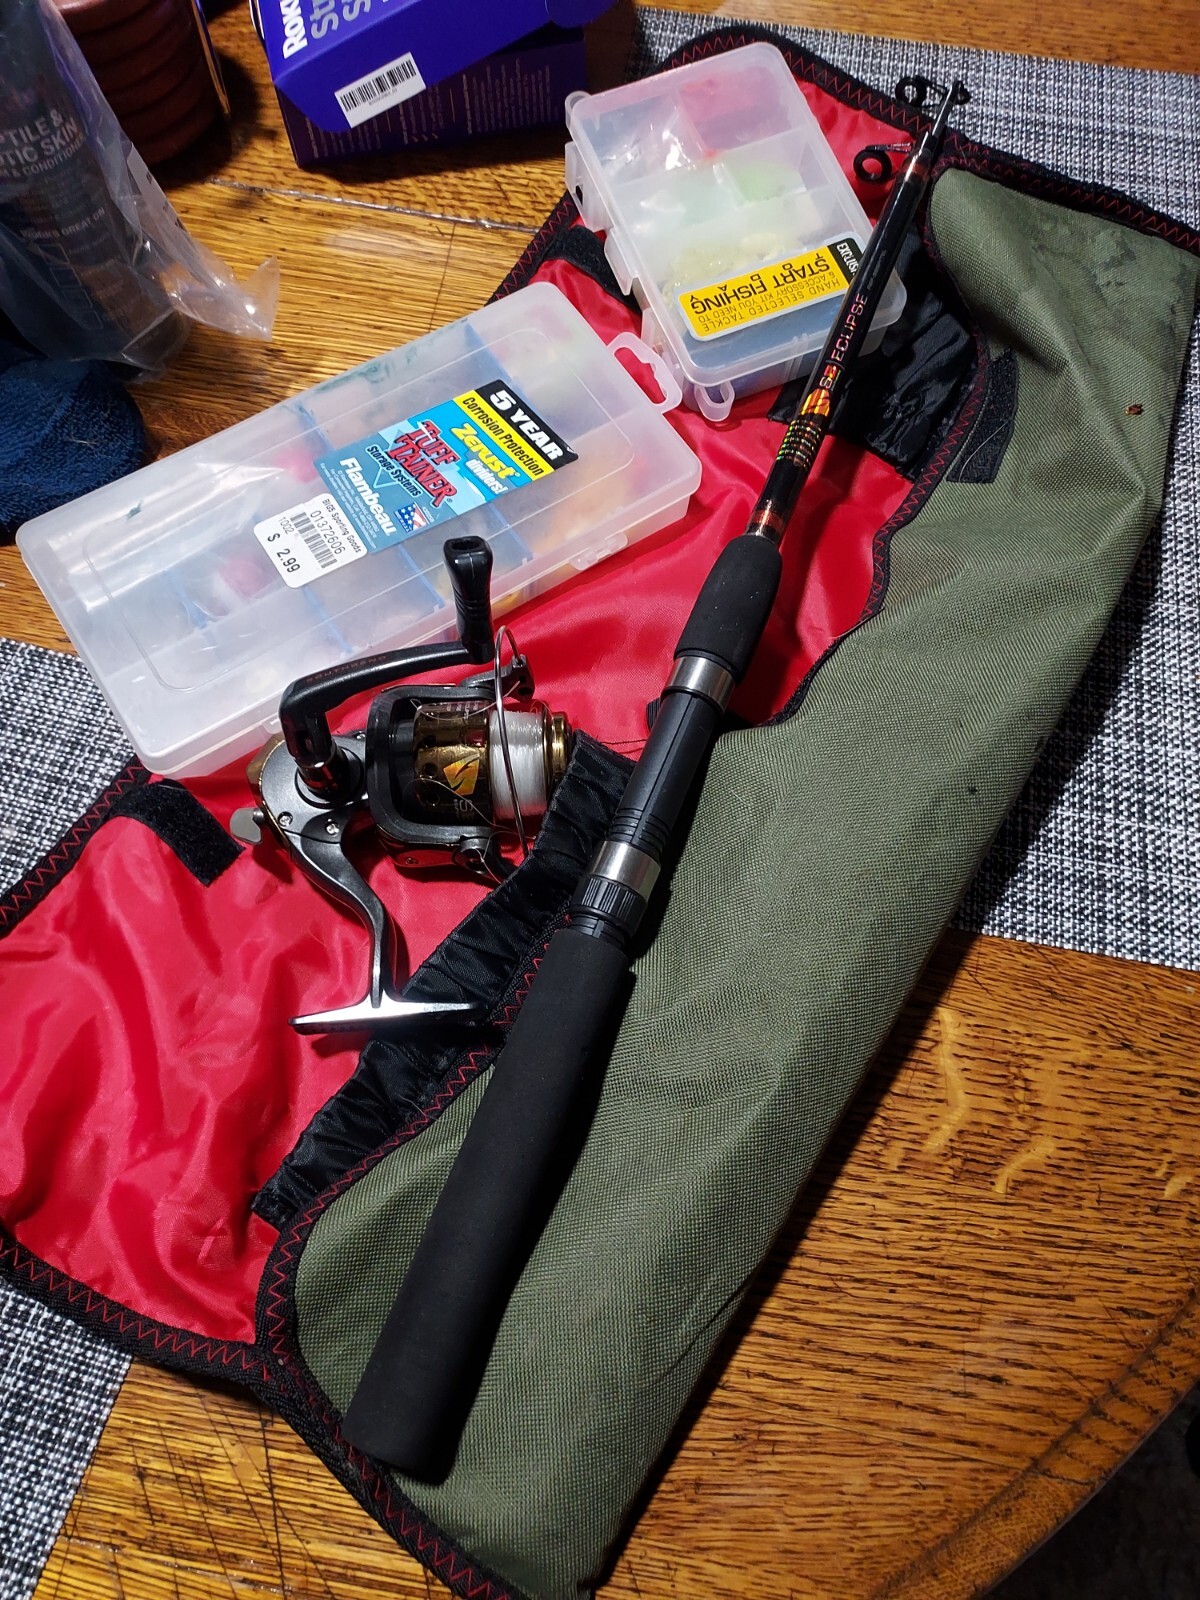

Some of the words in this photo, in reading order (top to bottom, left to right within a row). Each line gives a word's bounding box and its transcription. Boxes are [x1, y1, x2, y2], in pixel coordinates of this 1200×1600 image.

[279, 0, 308, 59] ROK
[41, 117, 78, 155] SKIN
[50, 109, 63, 128] &
[773, 258, 831, 288] START
[775, 274, 827, 298] ACCESSORY
[808, 278, 841, 297] HAND
[691, 279, 768, 315] FISHING
[712, 302, 737, 319] NEED
[738, 294, 757, 310] YOU
[749, 292, 805, 316] SELECTED
[757, 291, 775, 303] KIT
[697, 313, 711, 323] TO
[703, 312, 744, 332] TACKLE
[831, 292, 869, 362] ECLIPSE
[405, 419, 460, 466] TUFF
[462, 397, 504, 437] Corrosion
[500, 433, 545, 477] Protection
[489, 389, 517, 411] 5
[510, 408, 564, 461] YEAR
[366, 445, 395, 472] Storage
[390, 470, 422, 497] Systems
[385, 433, 458, 508] TAINER
[465, 459, 509, 494] dividers!
[340, 456, 397, 537] Flambeau
[279, 516, 295, 535] 1002
[310, 510, 346, 555] 01372606
[331, 512, 350, 536] Sporting
[346, 534, 362, 554] Goods
[276, 548, 301, 573] 2.99
